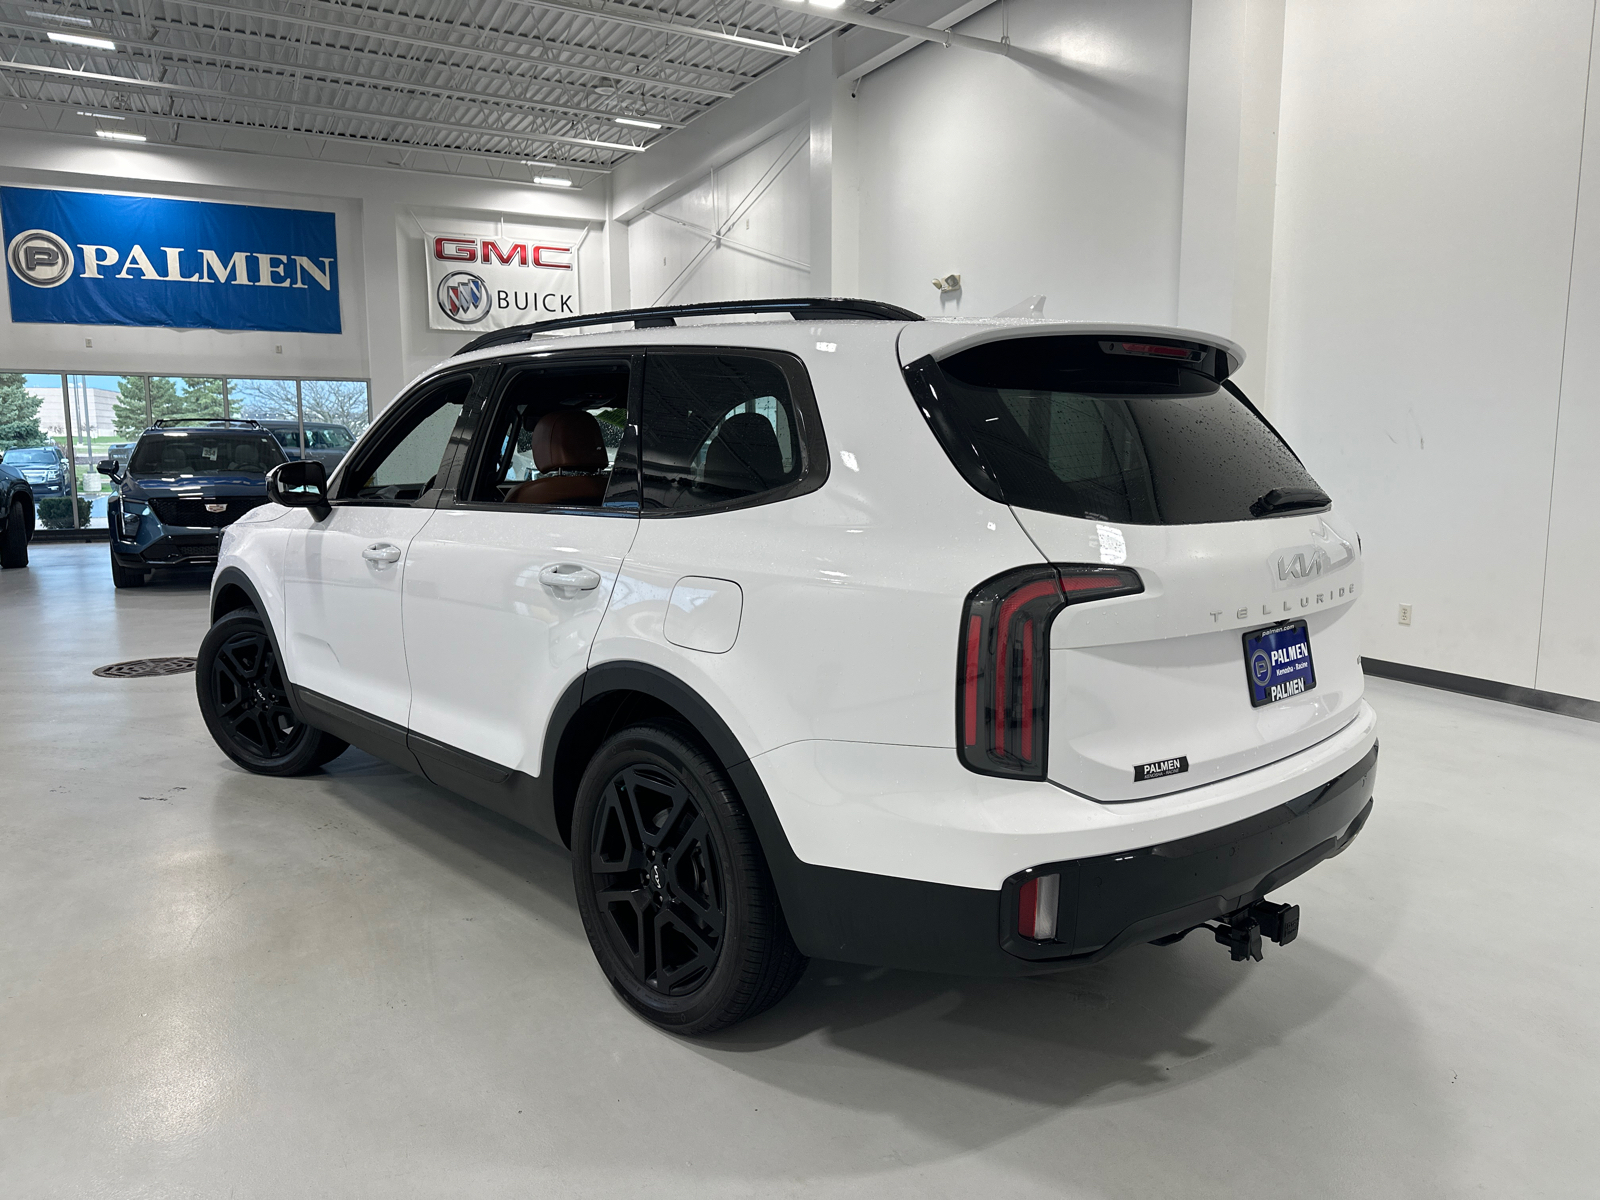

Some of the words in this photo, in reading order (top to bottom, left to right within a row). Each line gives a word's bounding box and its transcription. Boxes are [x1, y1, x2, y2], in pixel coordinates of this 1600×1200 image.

[433, 235, 573, 271] GMC
[77, 243, 335, 291] PALMEN
[497, 290, 574, 314] BUICK
[1277, 551, 1322, 581] KIA
[1209, 583, 1355, 623] TELLURIDE
[1261, 624, 1295, 638] palmen.com
[1270, 642, 1308, 667] PALMEN
[1276, 665, 1294, 677] Kenosha
[1295, 661, 1308, 671] Racine
[1270, 677, 1305, 702] PALMEN
[1143, 758, 1180, 775] PALMEN
